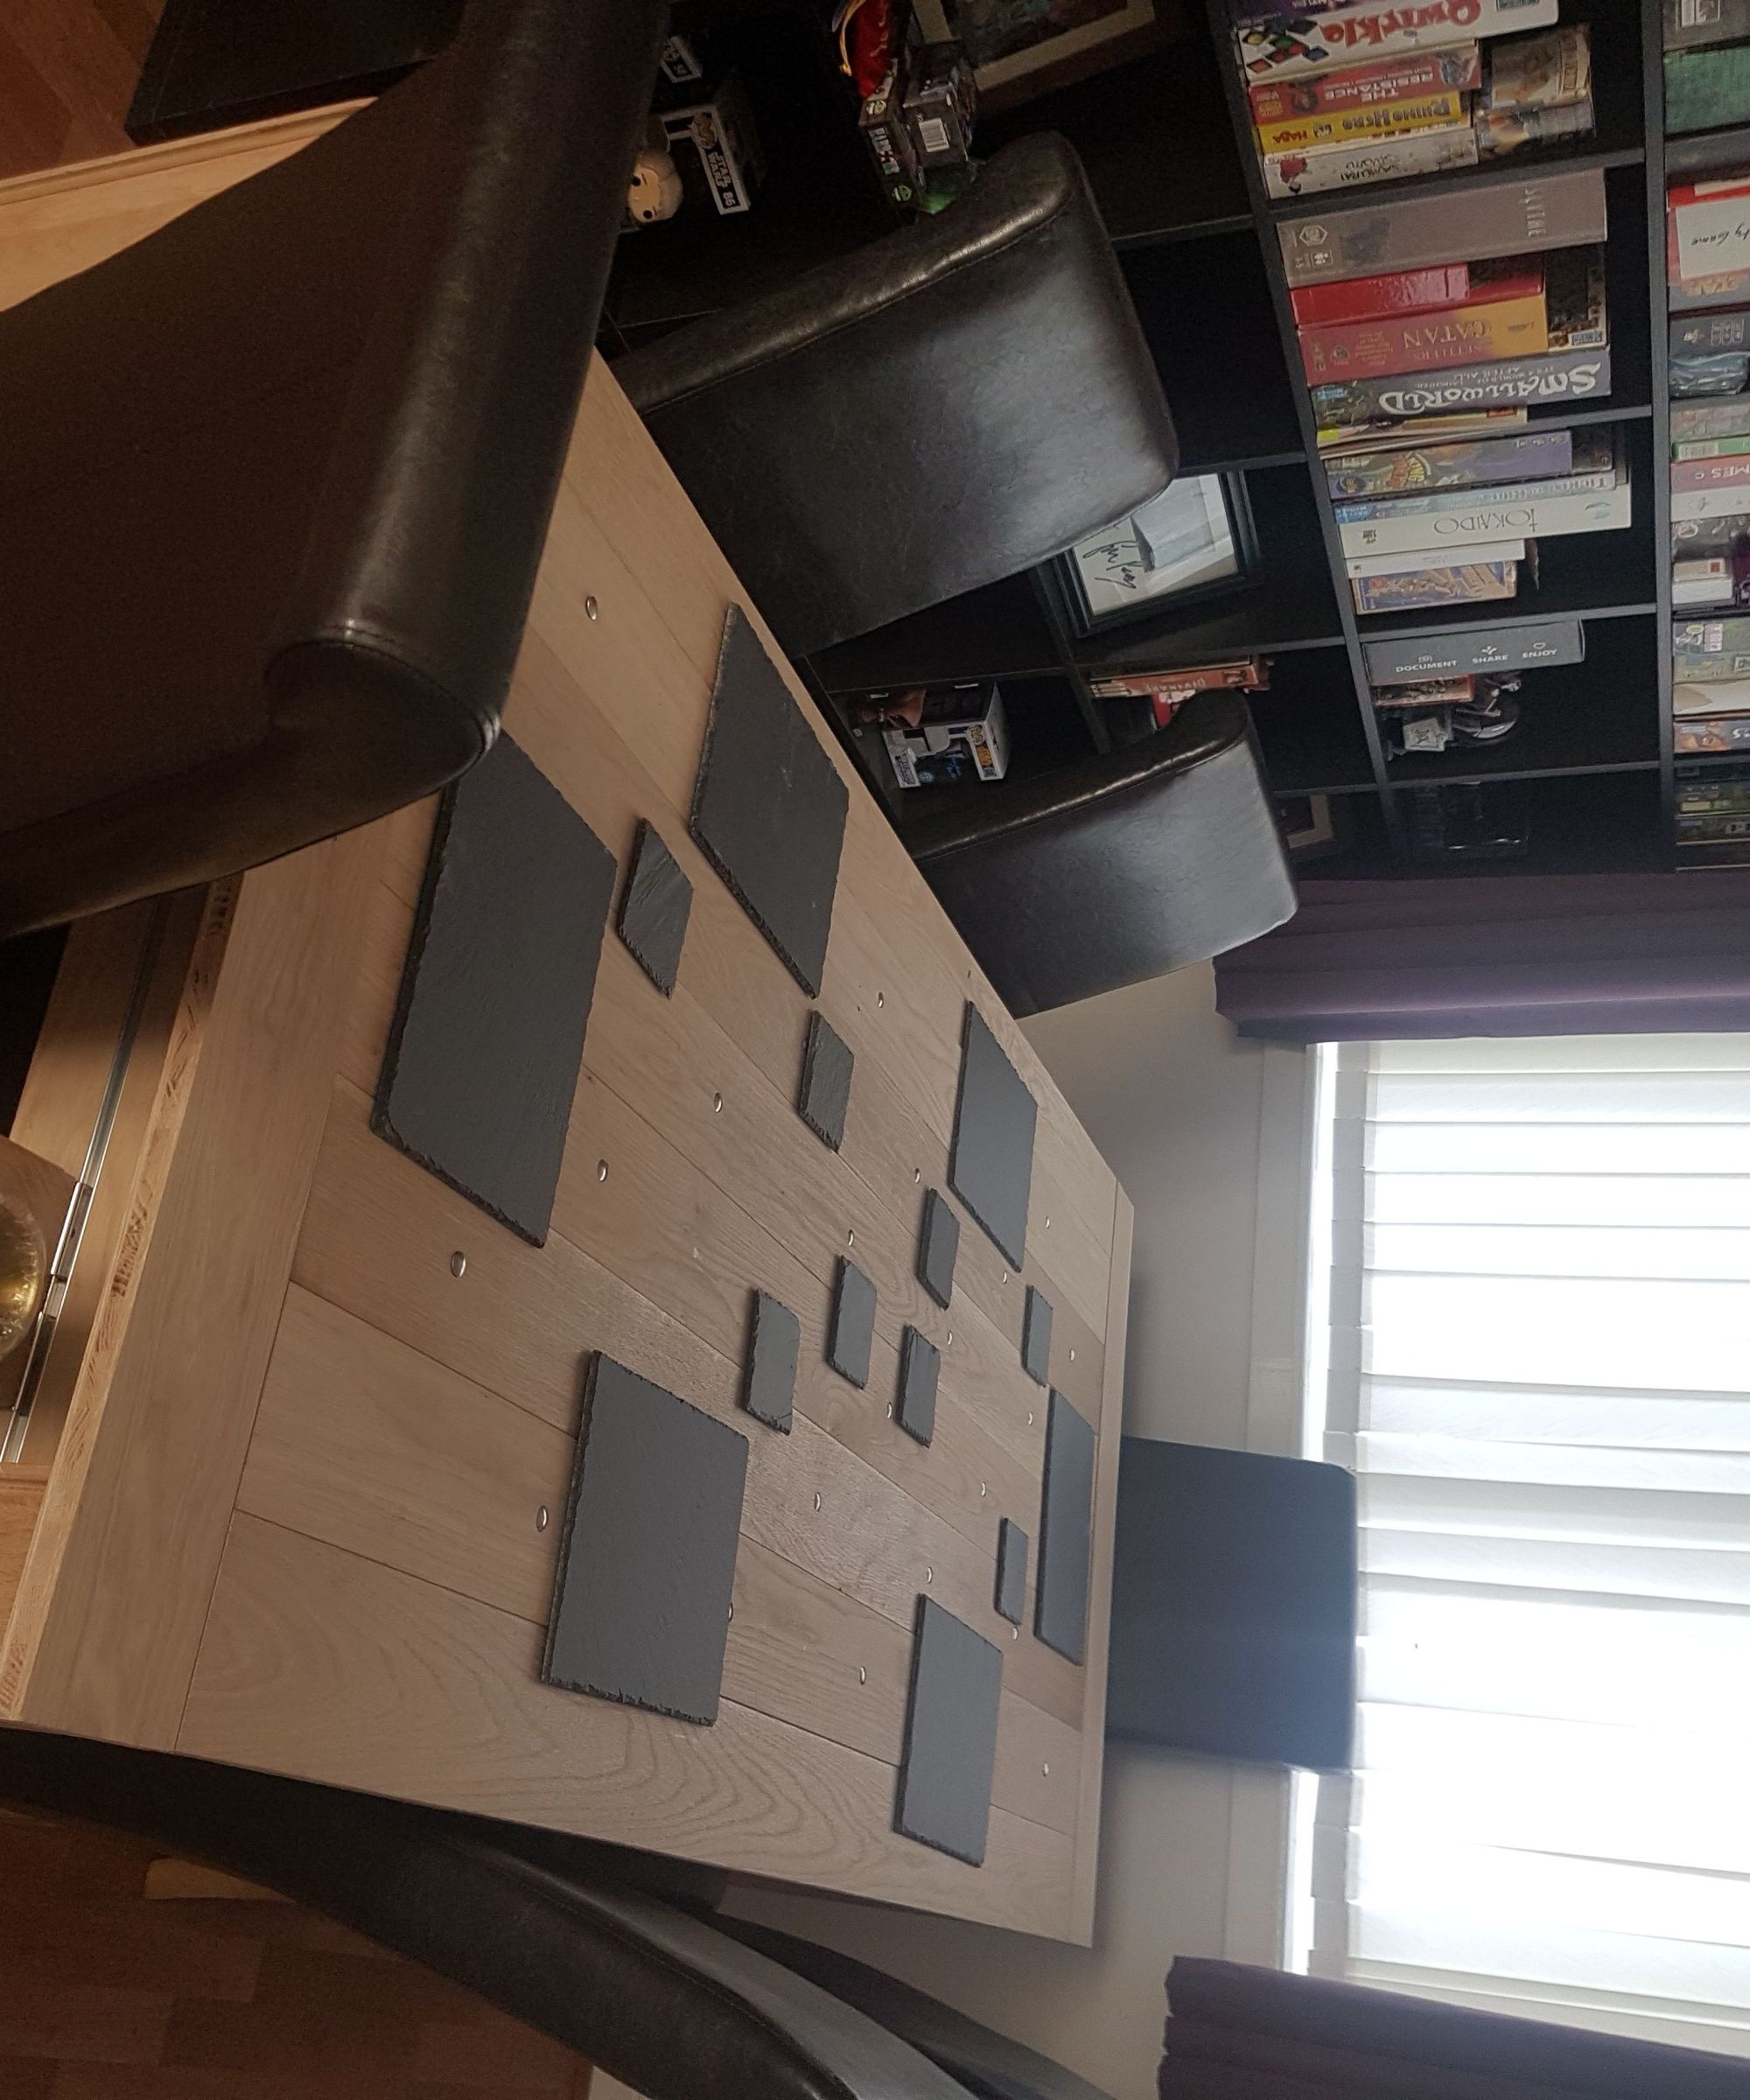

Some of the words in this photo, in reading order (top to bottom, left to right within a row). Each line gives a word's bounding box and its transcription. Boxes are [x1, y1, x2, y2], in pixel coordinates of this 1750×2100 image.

[1320, 1, 1481, 48] Qwirkle
[1324, 74, 1433, 101] RESISTANCE
[1361, 88, 1398, 102] THE
[1402, 321, 1485, 348] CATAN
[1472, 654, 1508, 664] SHARE
[1522, 648, 1558, 659] ENJOY
[1396, 660, 1458, 673] DOCUMENT
